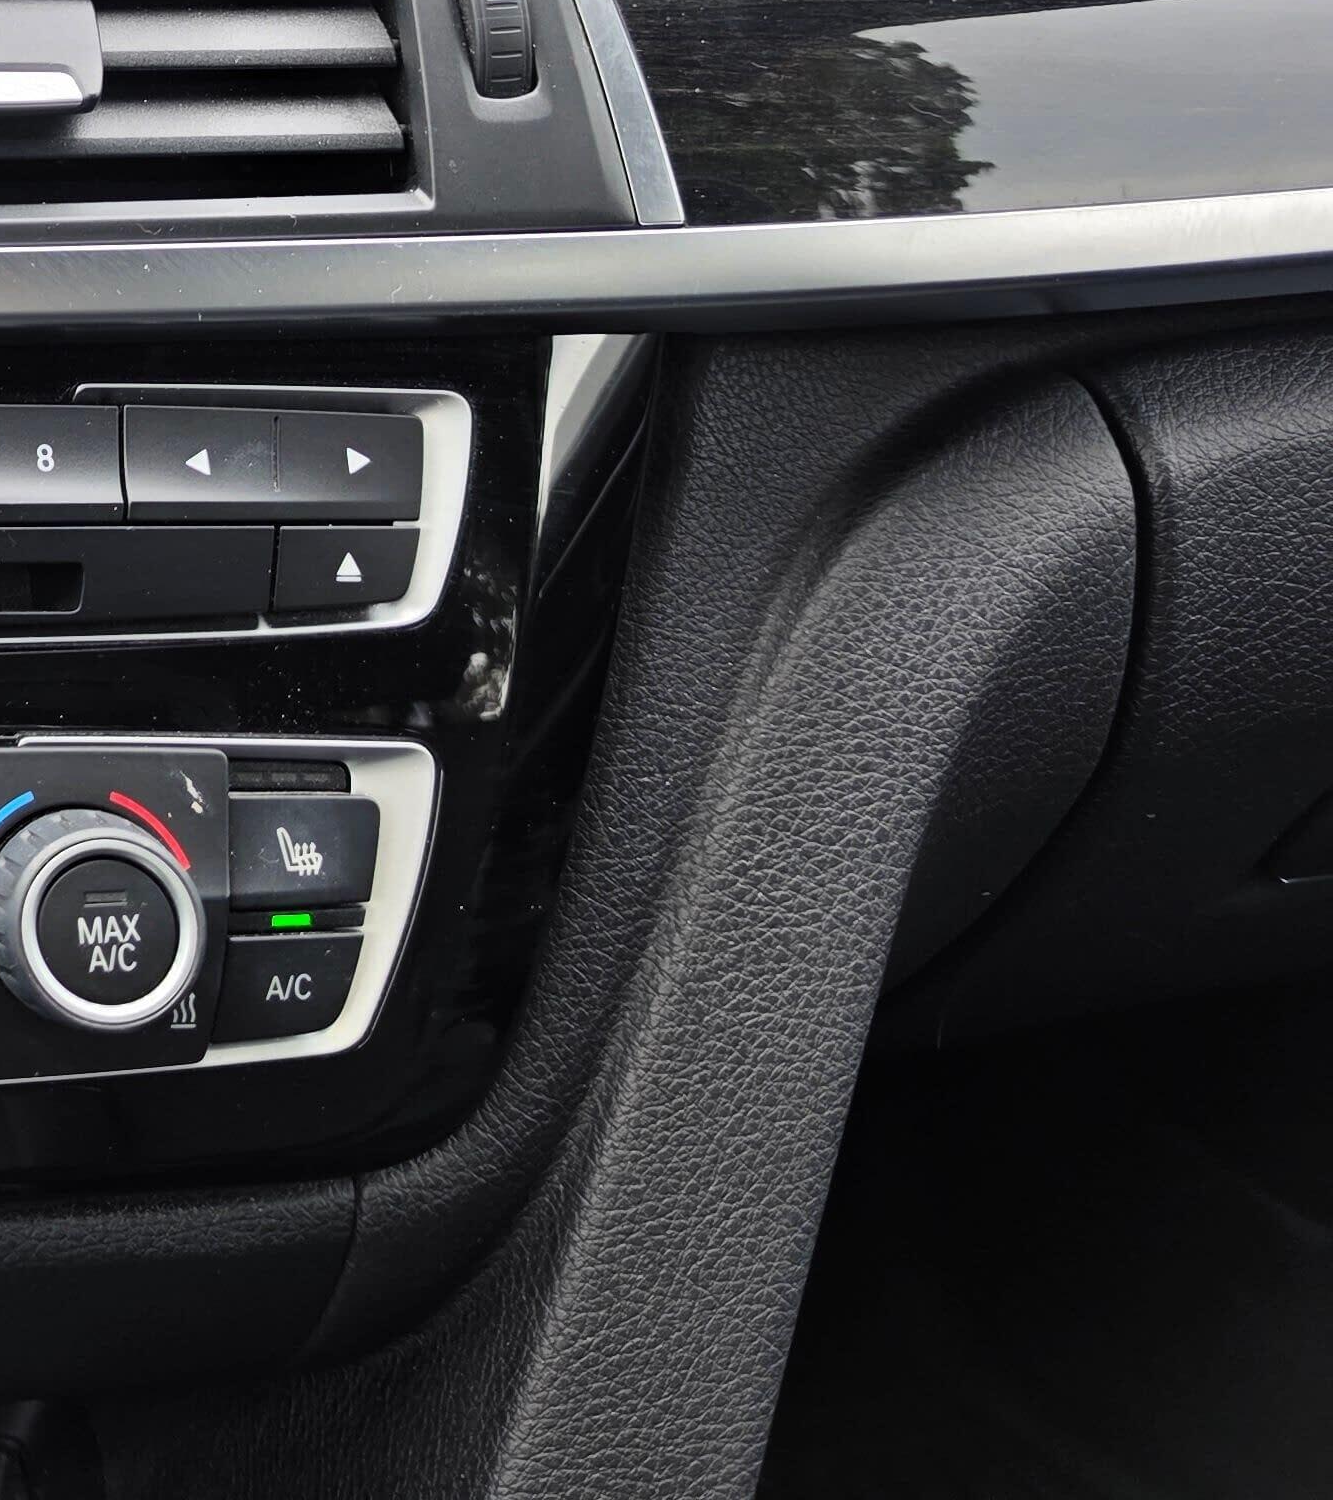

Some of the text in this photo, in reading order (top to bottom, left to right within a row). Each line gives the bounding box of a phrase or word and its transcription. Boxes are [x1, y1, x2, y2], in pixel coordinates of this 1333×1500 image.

[35, 444, 56, 473] 8
[76, 913, 142, 945] MAX
[87, 942, 138, 974] A/C
[265, 973, 313, 1001] A/C
